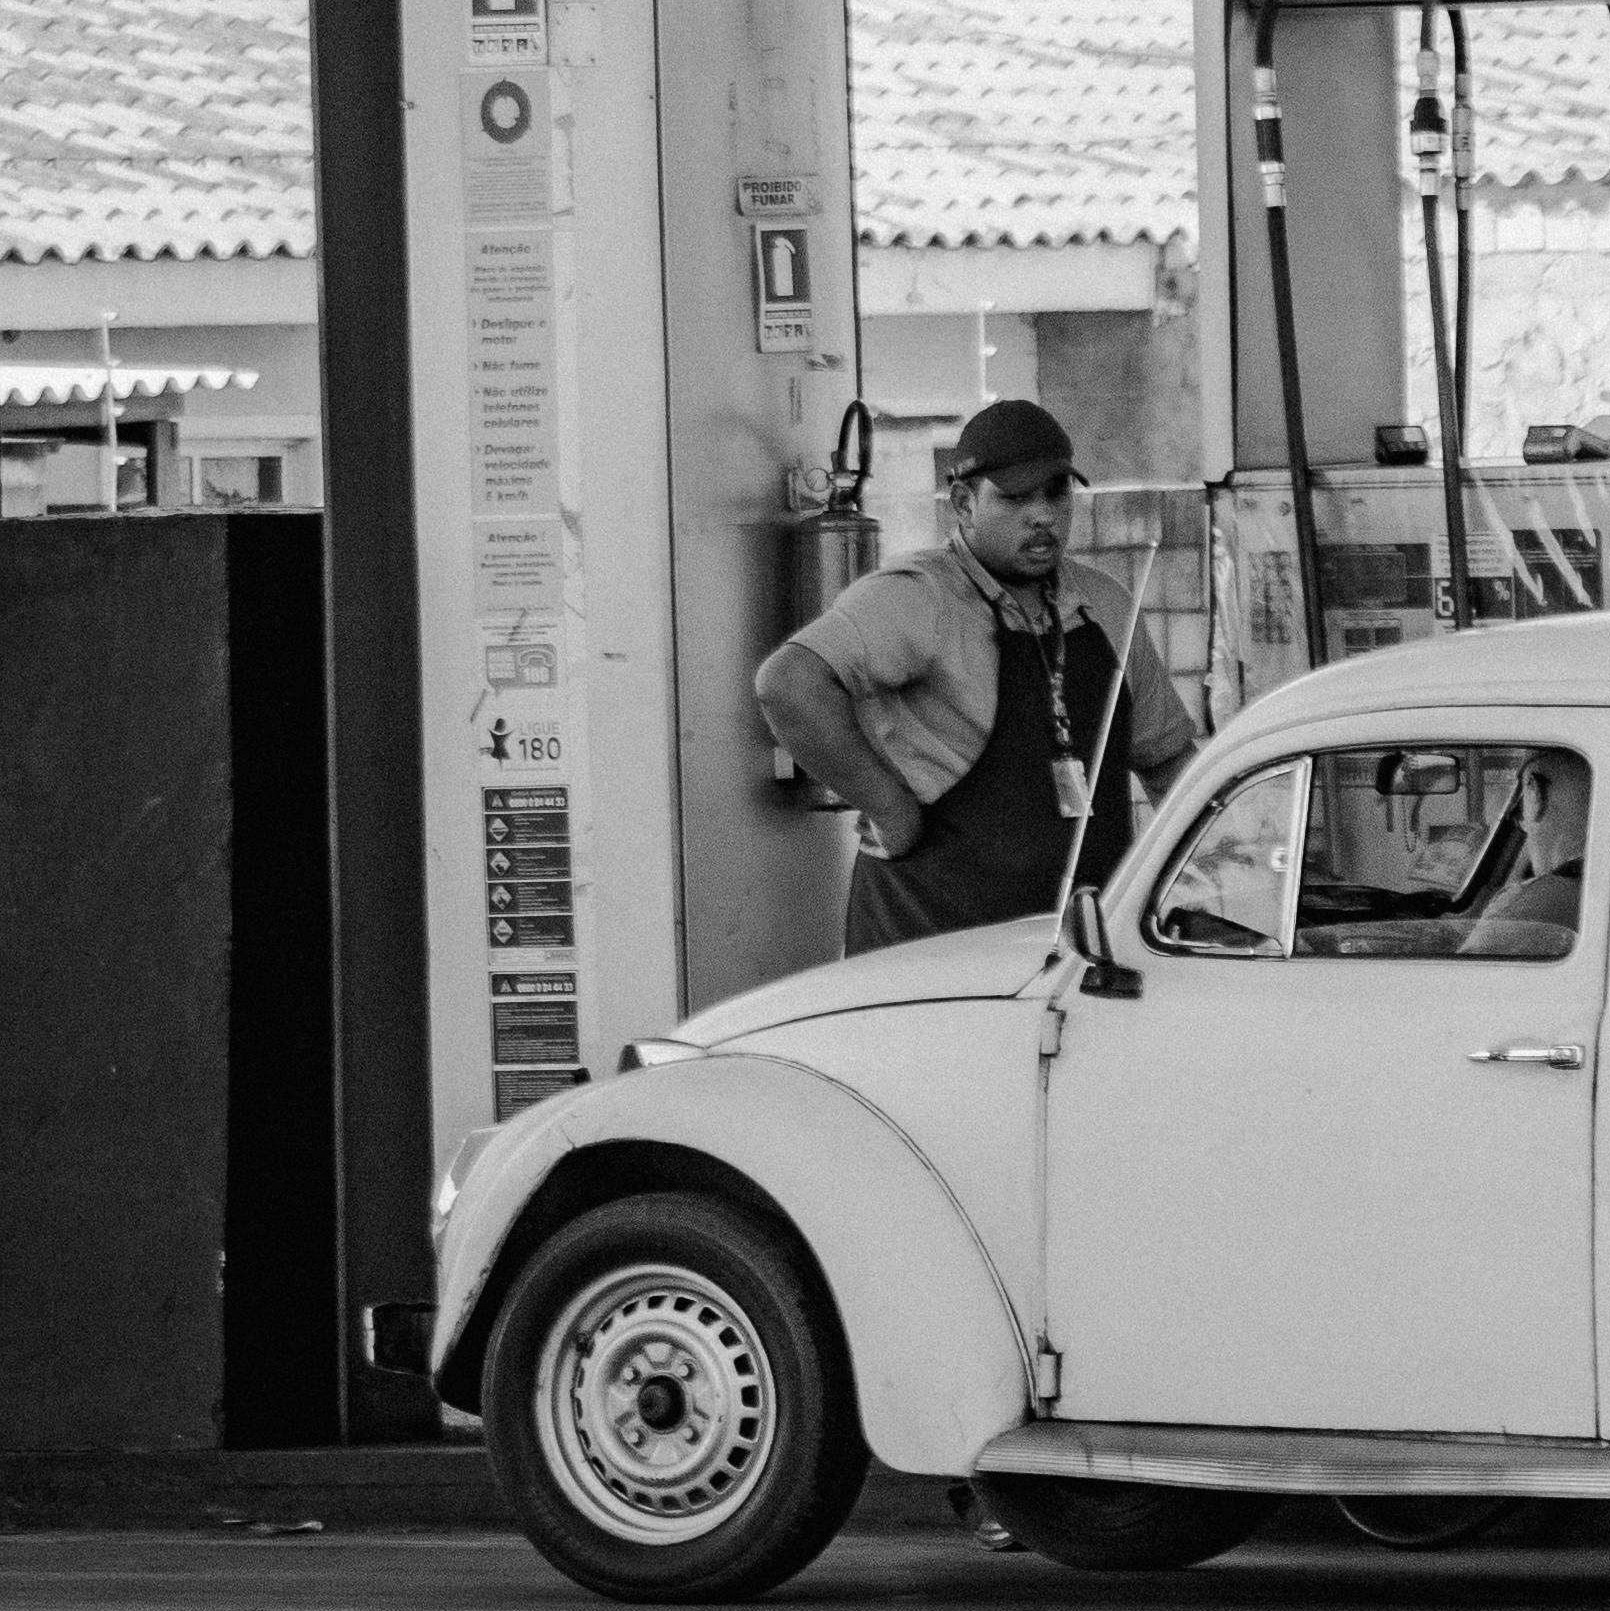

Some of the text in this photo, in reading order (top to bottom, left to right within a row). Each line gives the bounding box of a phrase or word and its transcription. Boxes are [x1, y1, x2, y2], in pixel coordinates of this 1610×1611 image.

[743, 181, 802, 193] PROIBIDO
[751, 194, 796, 207] FUMAR
[519, 721, 561, 736] LIGUE
[518, 737, 561, 760] 180
